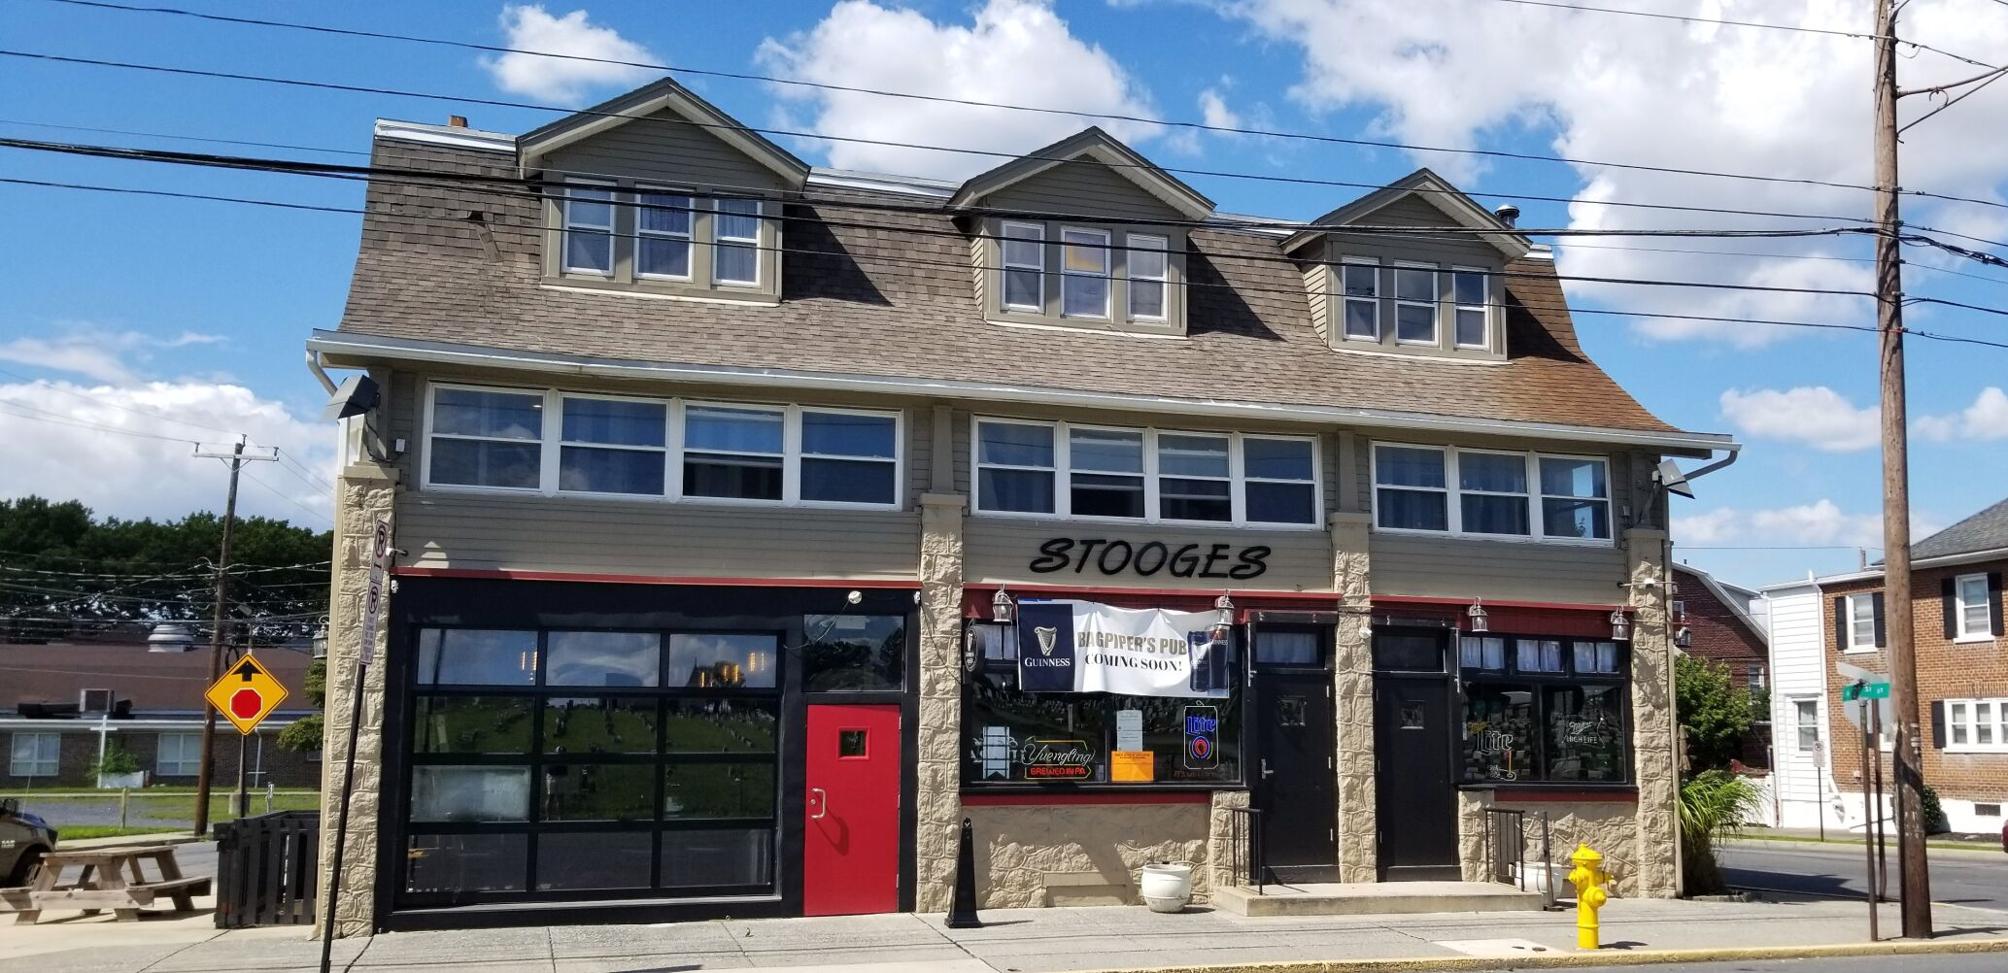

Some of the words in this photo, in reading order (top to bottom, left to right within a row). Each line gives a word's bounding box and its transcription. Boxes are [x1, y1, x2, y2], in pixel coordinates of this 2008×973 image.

[1029, 537, 1272, 580] STOOGES
[1077, 631, 1156, 654] BAGPIPER'S
[1159, 640, 1188, 656] PUB
[1024, 657, 1071, 668] GUINNESS
[1084, 652, 1139, 669] COMING
[1140, 658, 1182, 672] SOON!
[1185, 715, 1217, 736] Lite
[1476, 730, 1514, 757] Lite
[1583, 736, 1598, 744] LIFE
[1021, 743, 1094, 766] Yuengling
[1030, 767, 1065, 775] BREWED
